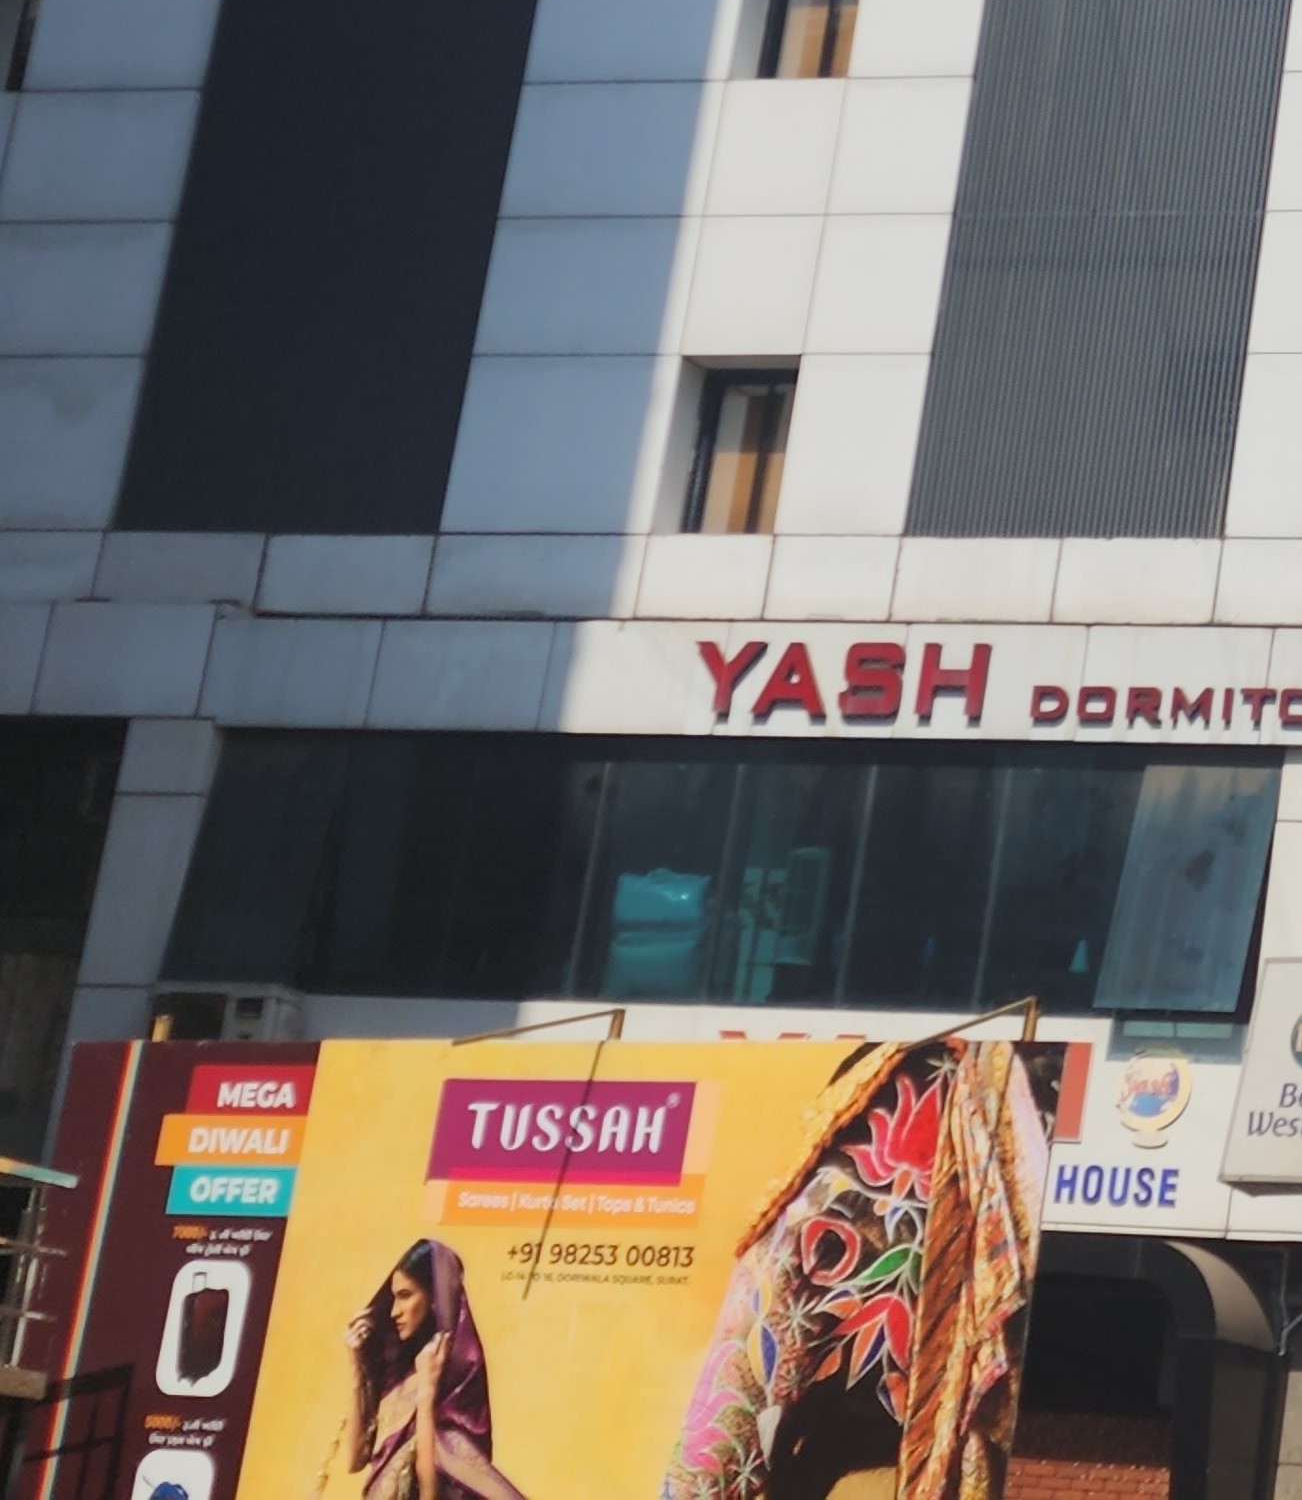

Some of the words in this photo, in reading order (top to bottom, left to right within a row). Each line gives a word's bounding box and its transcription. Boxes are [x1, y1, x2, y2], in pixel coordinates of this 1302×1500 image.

[697, 641, 993, 721] YASH
[216, 1080, 297, 1109] MEGA
[187, 1126, 292, 1155] DIWALI
[467, 1102, 669, 1155] TUSSAH
[188, 1175, 280, 1205] OFFER
[1053, 1163, 1180, 1208] HOUSE
[549, 1243, 619, 1266] 98253
[626, 1244, 696, 1269] 00813
